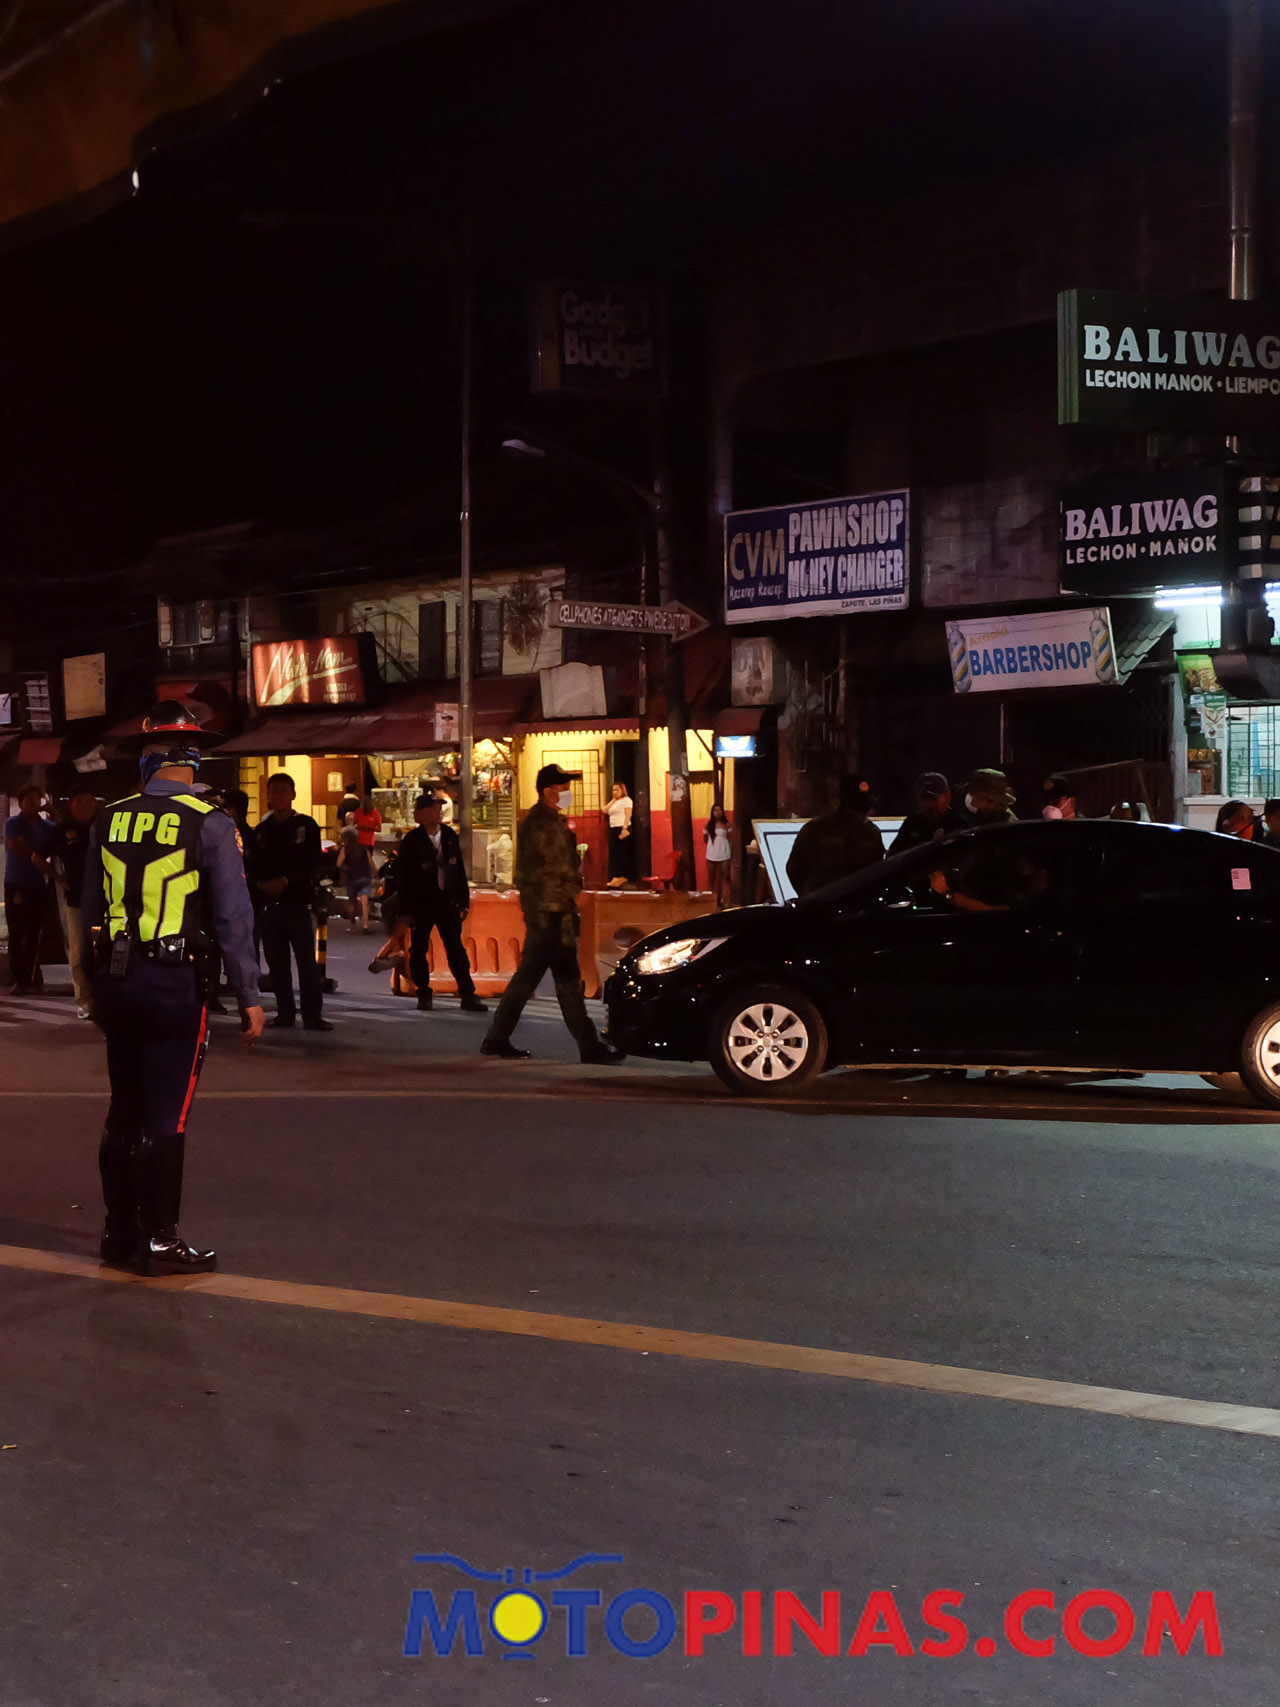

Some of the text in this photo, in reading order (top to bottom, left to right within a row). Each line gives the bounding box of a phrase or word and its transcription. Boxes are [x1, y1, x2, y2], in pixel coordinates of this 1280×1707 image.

[1083, 324, 1280, 370] BALIWAG
[1085, 369, 1280, 396] LECHON MANOK LIEMPO
[788, 499, 904, 554] PAWNSHOP
[1065, 494, 1219, 541] BALIWAG
[729, 528, 786, 581] CVM
[1066, 535, 1217, 564] LECHON MANOK
[787, 549, 904, 599] MONEY CHANGER
[969, 641, 1092, 676] BARBERSHOP
[108, 811, 181, 846] HPG
